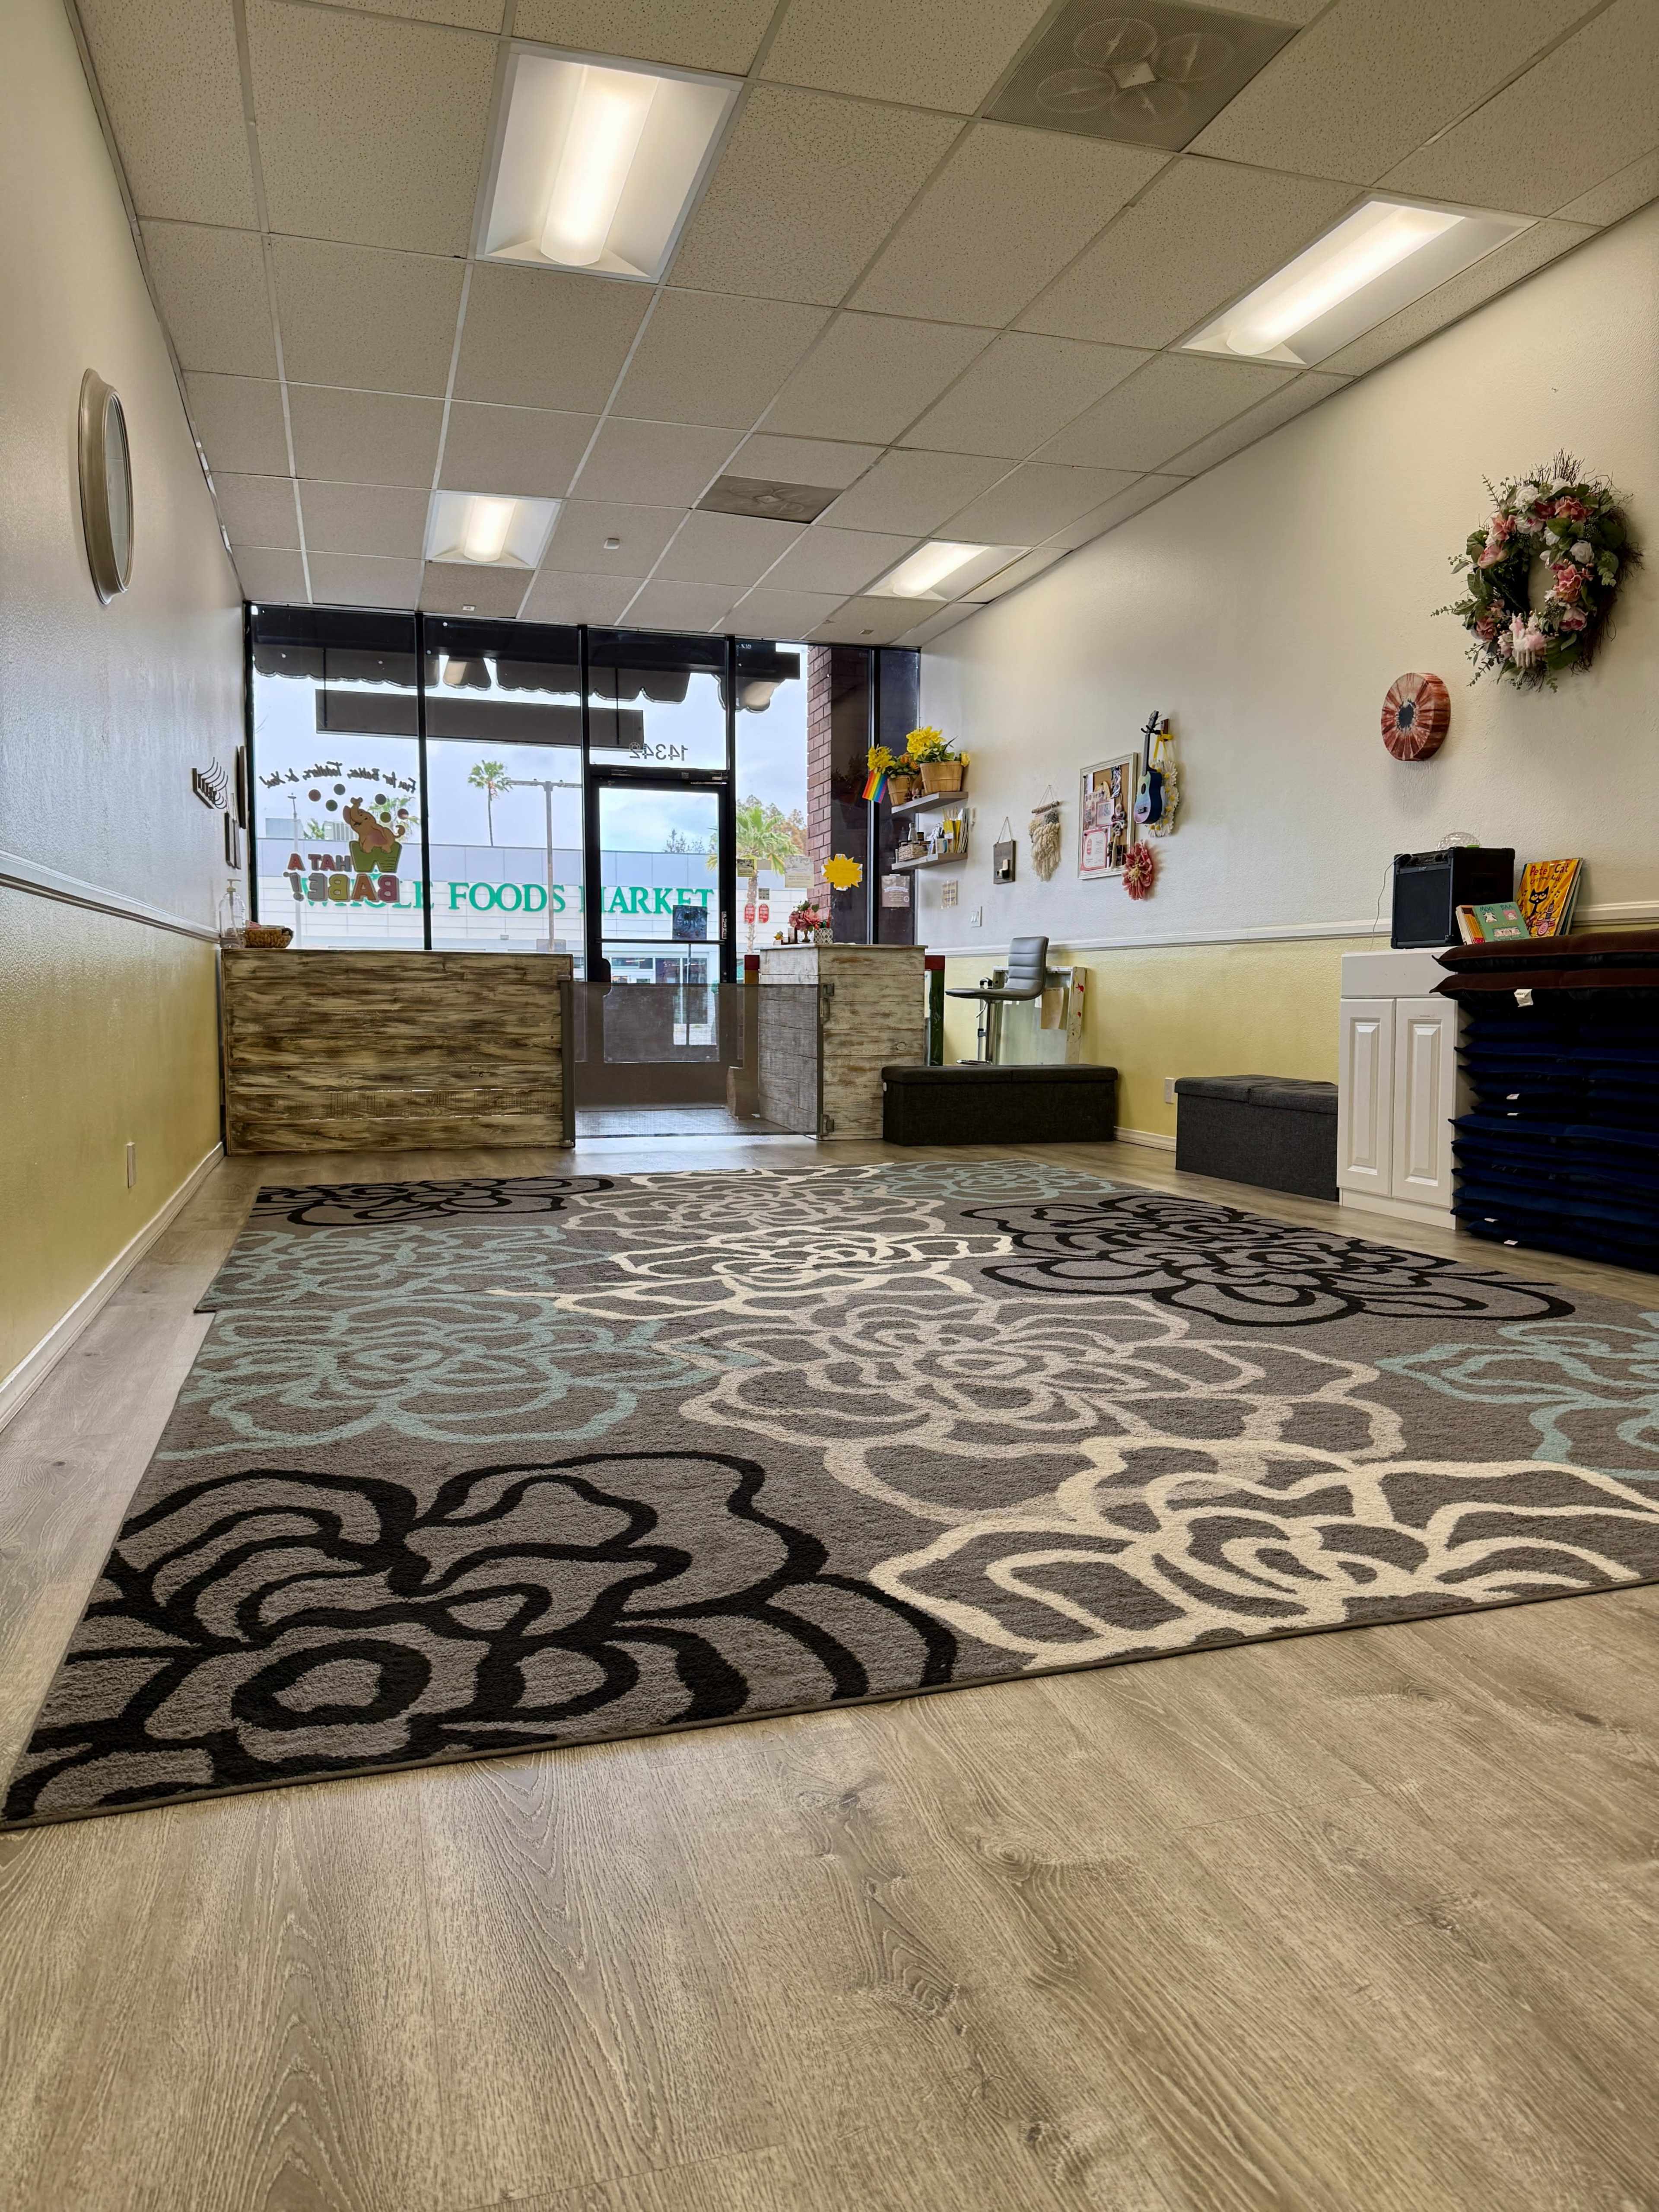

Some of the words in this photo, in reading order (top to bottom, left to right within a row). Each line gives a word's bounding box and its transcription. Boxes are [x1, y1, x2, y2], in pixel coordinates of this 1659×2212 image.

[1529, 865, 1548, 876] Pete
[1554, 863, 1569, 873] Cat
[448, 882, 566, 913] FOODS
